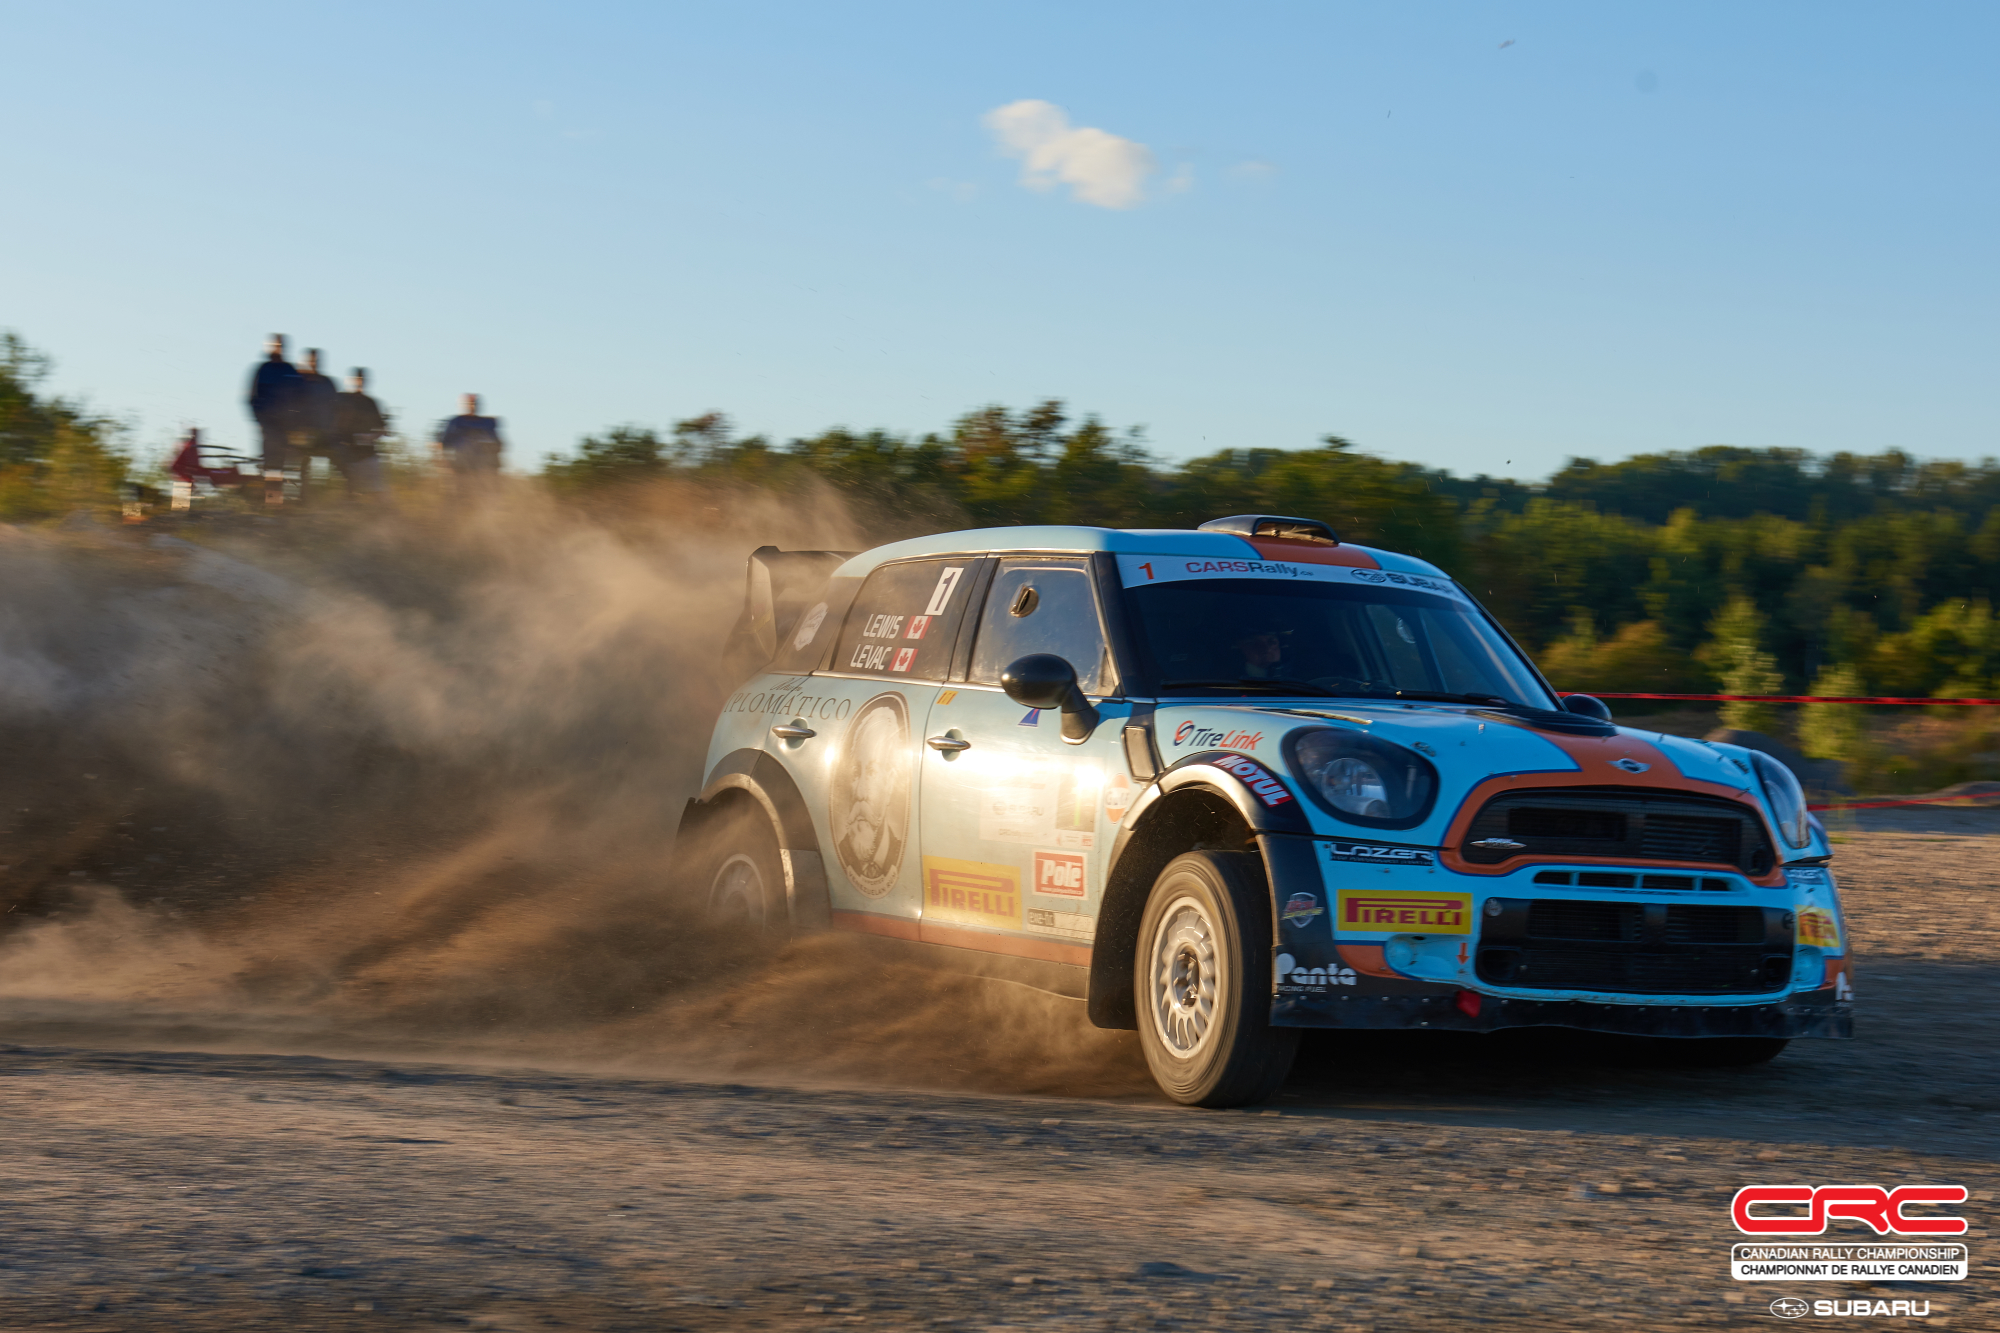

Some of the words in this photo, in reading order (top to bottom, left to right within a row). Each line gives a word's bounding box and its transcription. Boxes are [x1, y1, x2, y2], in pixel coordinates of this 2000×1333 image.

[1138, 562, 1155, 580] 1
[935, 571, 956, 611] 1
[863, 614, 904, 639] LEWIS
[850, 644, 892, 670] LEVAC
[724, 691, 852, 721] IPLOMÁTICO
[1187, 727, 1264, 751] TireLink
[1214, 753, 1293, 807] MOTUL
[1331, 843, 1434, 860] LAZER
[929, 868, 1015, 917] PIRELLI
[1345, 897, 1463, 926] PIRELLI
[1275, 953, 1357, 986] Panta
